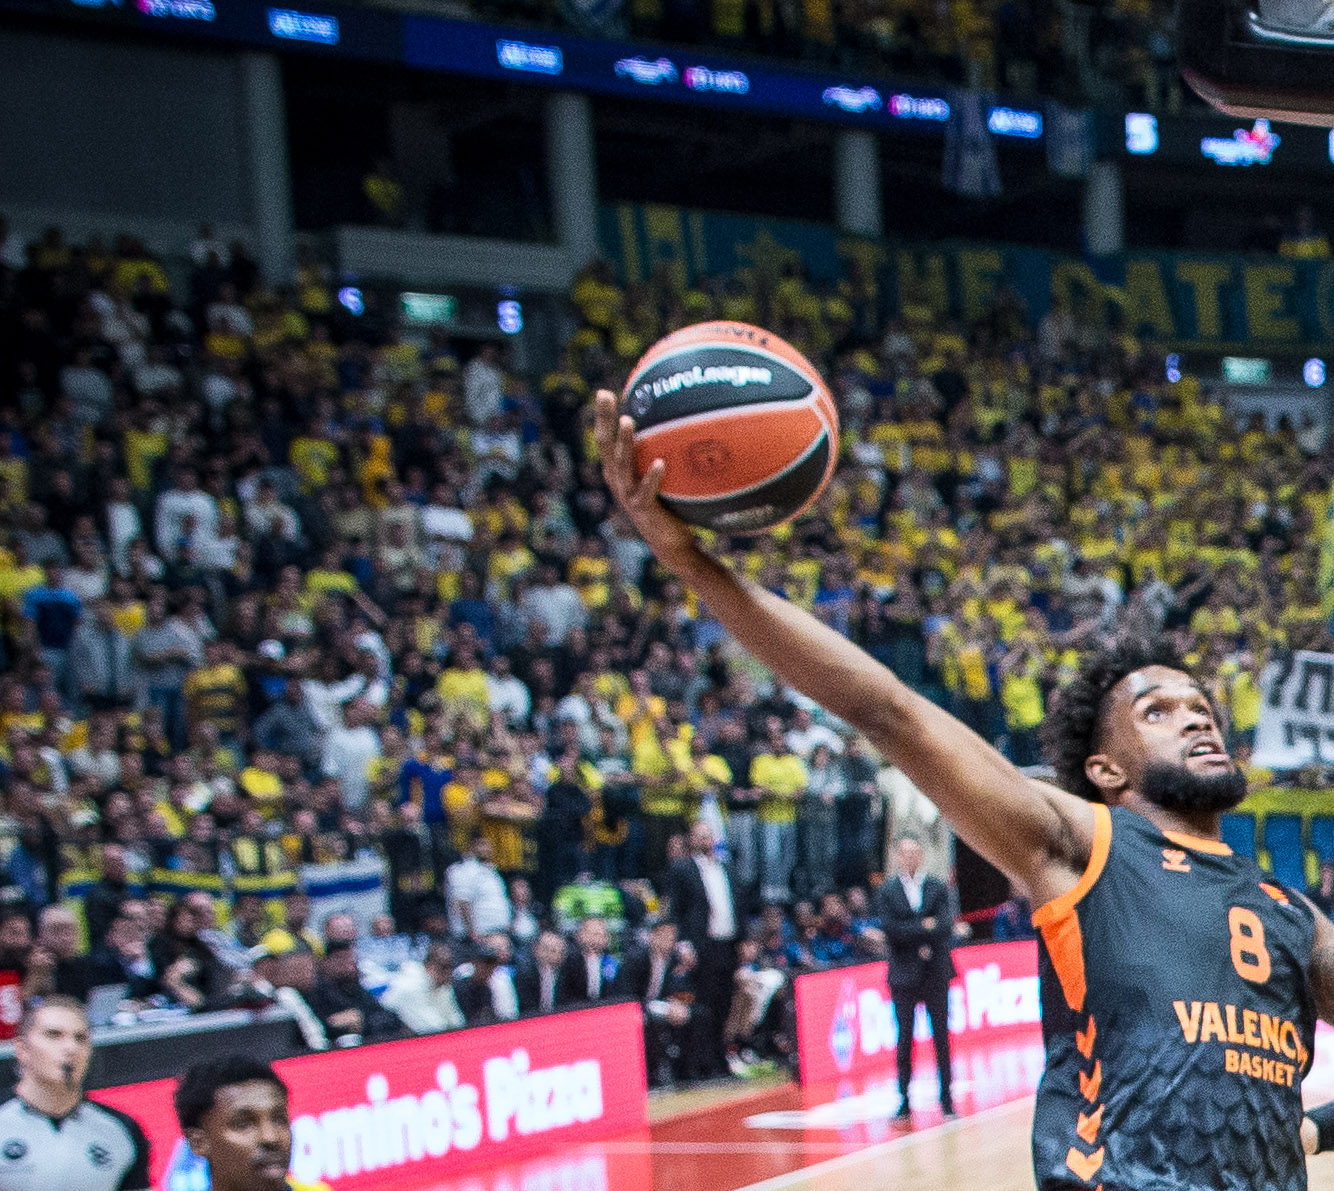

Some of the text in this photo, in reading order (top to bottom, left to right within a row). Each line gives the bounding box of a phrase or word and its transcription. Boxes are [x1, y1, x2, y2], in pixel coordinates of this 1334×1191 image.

[1228, 906, 1271, 983] 8
[1224, 1048, 1296, 1088] BASKET
[289, 1046, 603, 1184] omino's Pizza
